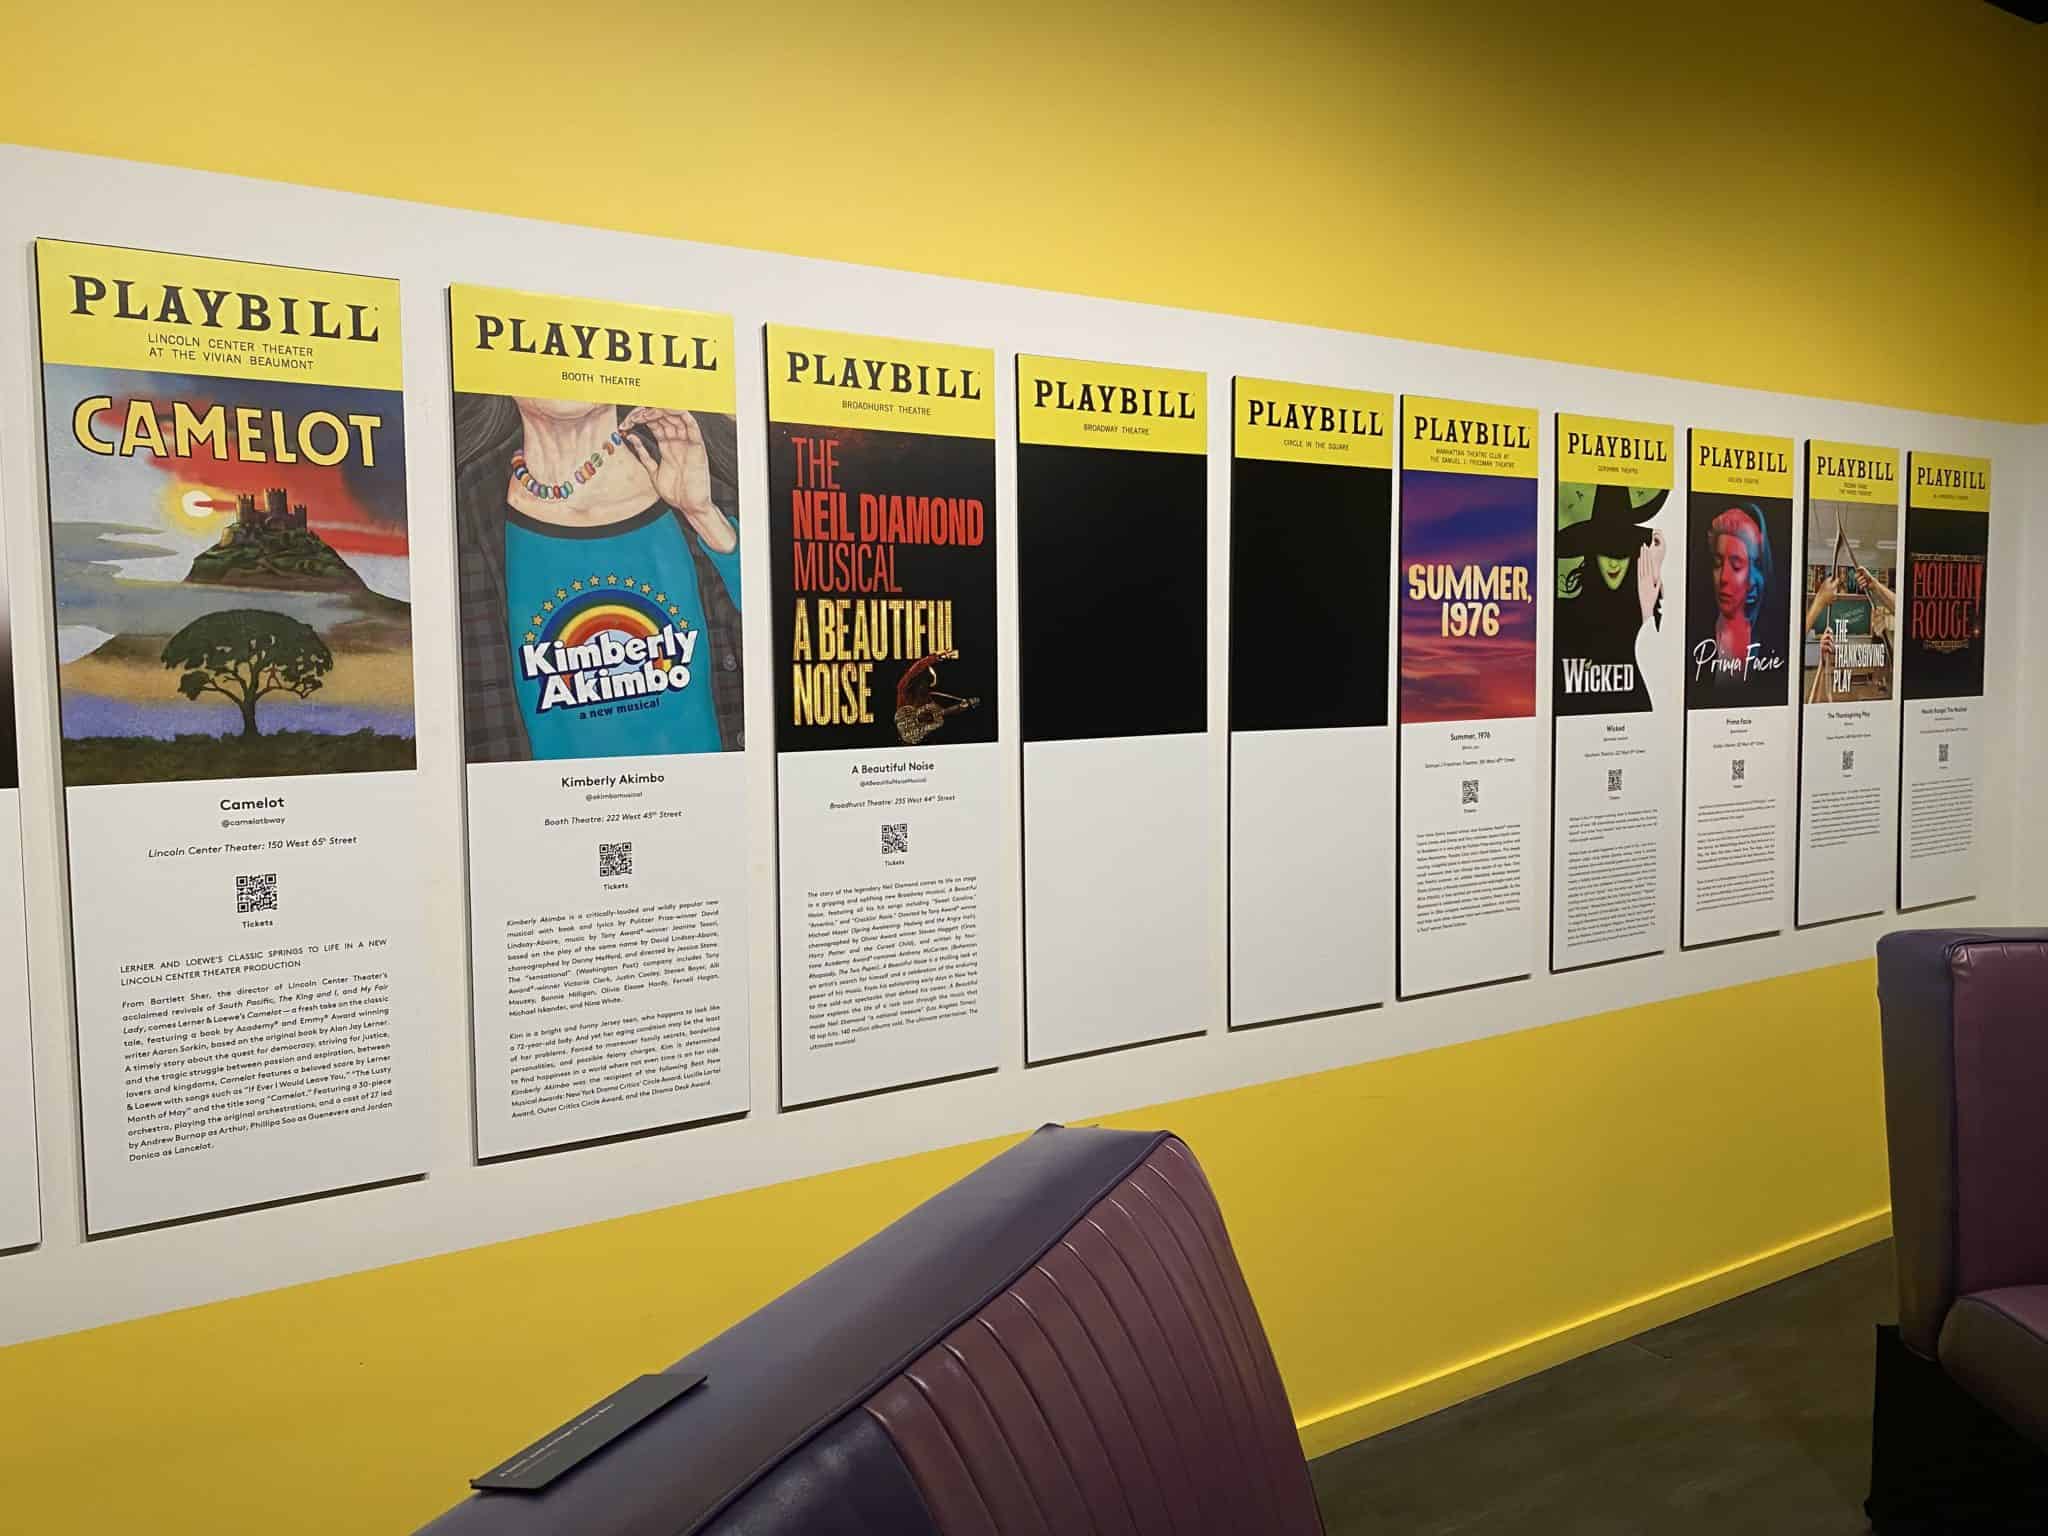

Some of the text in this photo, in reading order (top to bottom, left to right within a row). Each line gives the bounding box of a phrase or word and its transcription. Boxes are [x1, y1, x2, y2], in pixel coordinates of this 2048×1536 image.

[69, 274, 379, 342] PLAYBILL
[147, 334, 314, 357] LINCOLN CENTER THEATER
[149, 347, 314, 368] AT THE VIVIAN BEAUMONT
[475, 314, 718, 371] PLAYBILL
[561, 371, 640, 386] BOOTH THEATRE
[787, 351, 981, 400] PLAYBILL
[841, 400, 931, 415] BROADHURST THEATRE
[1034, 379, 1196, 420] PLAYBILL
[73, 395, 381, 468] CAMELOT
[1083, 423, 1149, 435] BROADWAY THEATRE
[1248, 399, 1384, 437] PLAYBILL
[1414, 415, 1530, 449] PLAYBILL
[1283, 439, 1302, 447] CIRCLE
[1305, 440, 1312, 448] IN
[1315, 440, 1325, 448] THE
[1568, 432, 1667, 462] PLAYBILL
[792, 437, 840, 489] THE
[1700, 445, 1787, 474] PLAYBILL
[1817, 456, 1894, 482] PLAYBILL
[1917, 466, 1986, 491] PLAYBILL
[792, 490, 984, 546] NEIL DIAMOND
[793, 542, 903, 592] MUSICAL
[1912, 561, 1973, 600] MOULIN
[1408, 564, 1533, 604] SUMMER,
[793, 598, 959, 661] A BEAUTIFUL
[1441, 602, 1500, 638] 1976
[1835, 619, 1849, 643] THE
[520, 624, 699, 680] Kimberly
[1693, 638, 1785, 682] Prima Facie
[1834, 644, 1885, 668] THANKSGIVING
[537, 664, 692, 713] Akimbo
[793, 663, 874, 726] NOISE
[1833, 669, 1852, 693] PLAY
[579, 699, 660, 720] a new musical
[561, 773, 664, 787] Kimberly Akimbo
[851, 761, 934, 774] A Beautiful Noise
[219, 797, 284, 810] Camelot
[544, 818, 568, 826] Booth
[606, 814, 620, 822] 222
[148, 847, 184, 857] Lincoln
[188, 846, 222, 855] Center
[225, 843, 264, 851] Theater:
[268, 840, 283, 848] 150
[285, 839, 308, 847] West
[329, 836, 357, 844] Street
[242, 920, 273, 928] Tickets
[120, 963, 154, 973] LERNER
[160, 960, 180, 968] AND
[185, 955, 222, 966] LOEWE'S
[228, 951, 263, 961] CLASSIC
[268, 947, 303, 957] SPRINGS
[324, 943, 339, 952] LIFE
[368, 939, 387, 947] NEW
[120, 960, 301, 986] LINCOLN CENTER THEATER PRODUCTION
[121, 1000, 144, 1008] From
[150, 995, 184, 1005] Bartlett
[236, 986, 268, 995] director
[288, 980, 317, 989] Lincoln
[322, 977, 348, 985] Center
[122, 1009, 168, 1021] acclaimed
[171, 1005, 203, 1015] revivals
[206, 1003, 215, 1011] of
[218, 1000, 243, 1010] South
[316, 989, 332, 998] and
[342, 987, 357, 995] and
[374, 983, 388, 991] Fair
[146, 1033, 188, 1043] featuring
[199, 1028, 220, 1037] book
[223, 1027, 233, 1035] by
[281, 1018, 297, 1026] and
[331, 1011, 356, 1019] Award
[358, 1008, 389, 1016] winning
[128, 1152, 160, 1161] Danica
